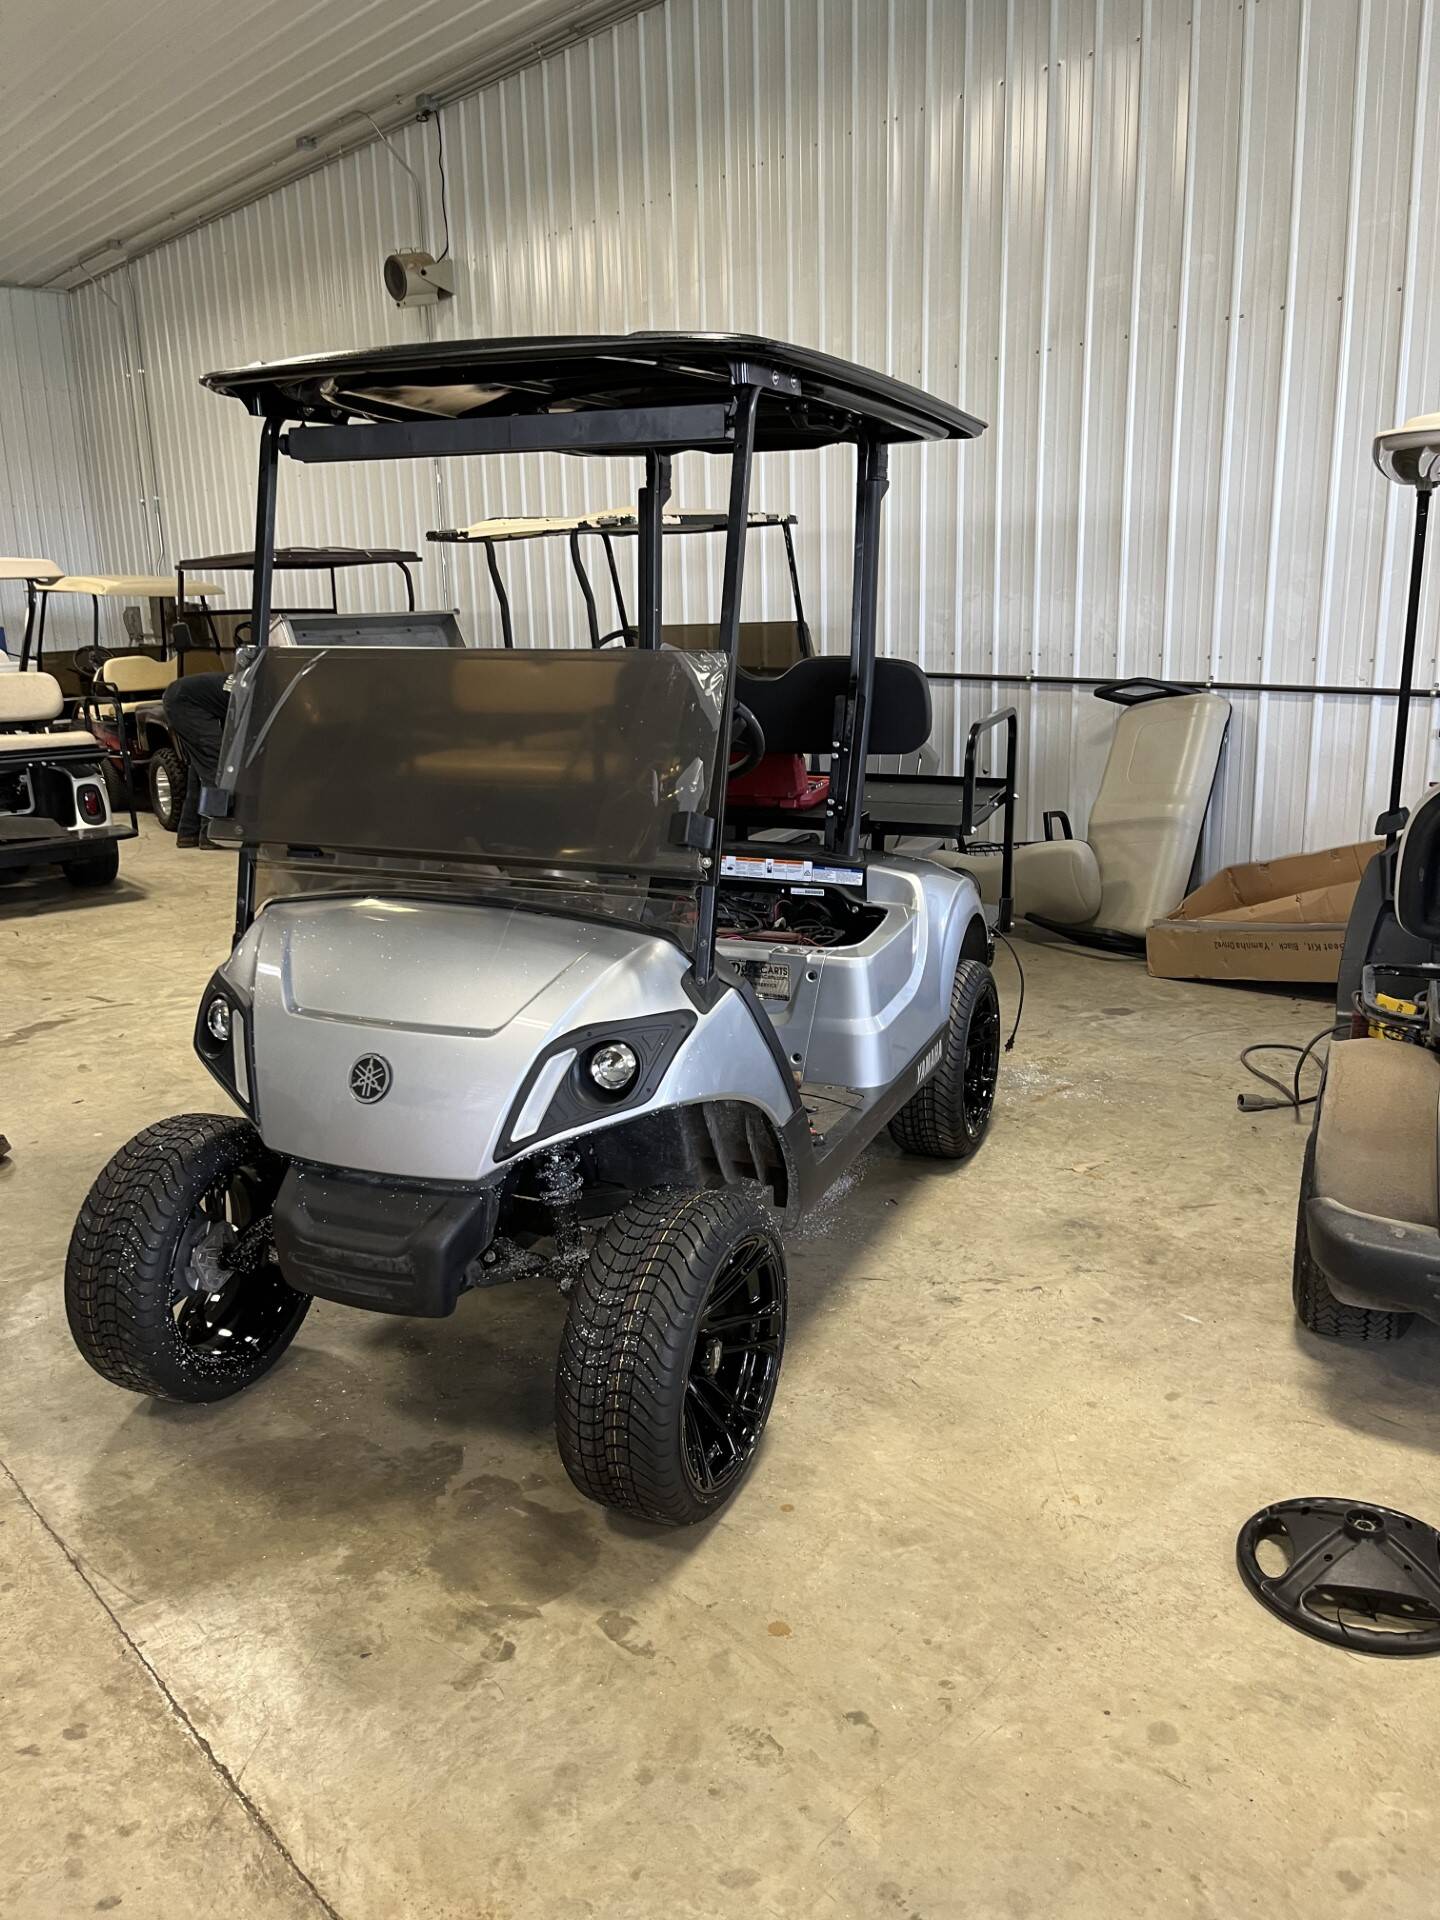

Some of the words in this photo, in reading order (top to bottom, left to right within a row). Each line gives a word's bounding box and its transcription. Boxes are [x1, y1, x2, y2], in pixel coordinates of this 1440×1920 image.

[1278, 941, 1299, 952] Black
[760, 965, 788, 976] CARTS
[917, 1039, 942, 1085] YAMAHA
